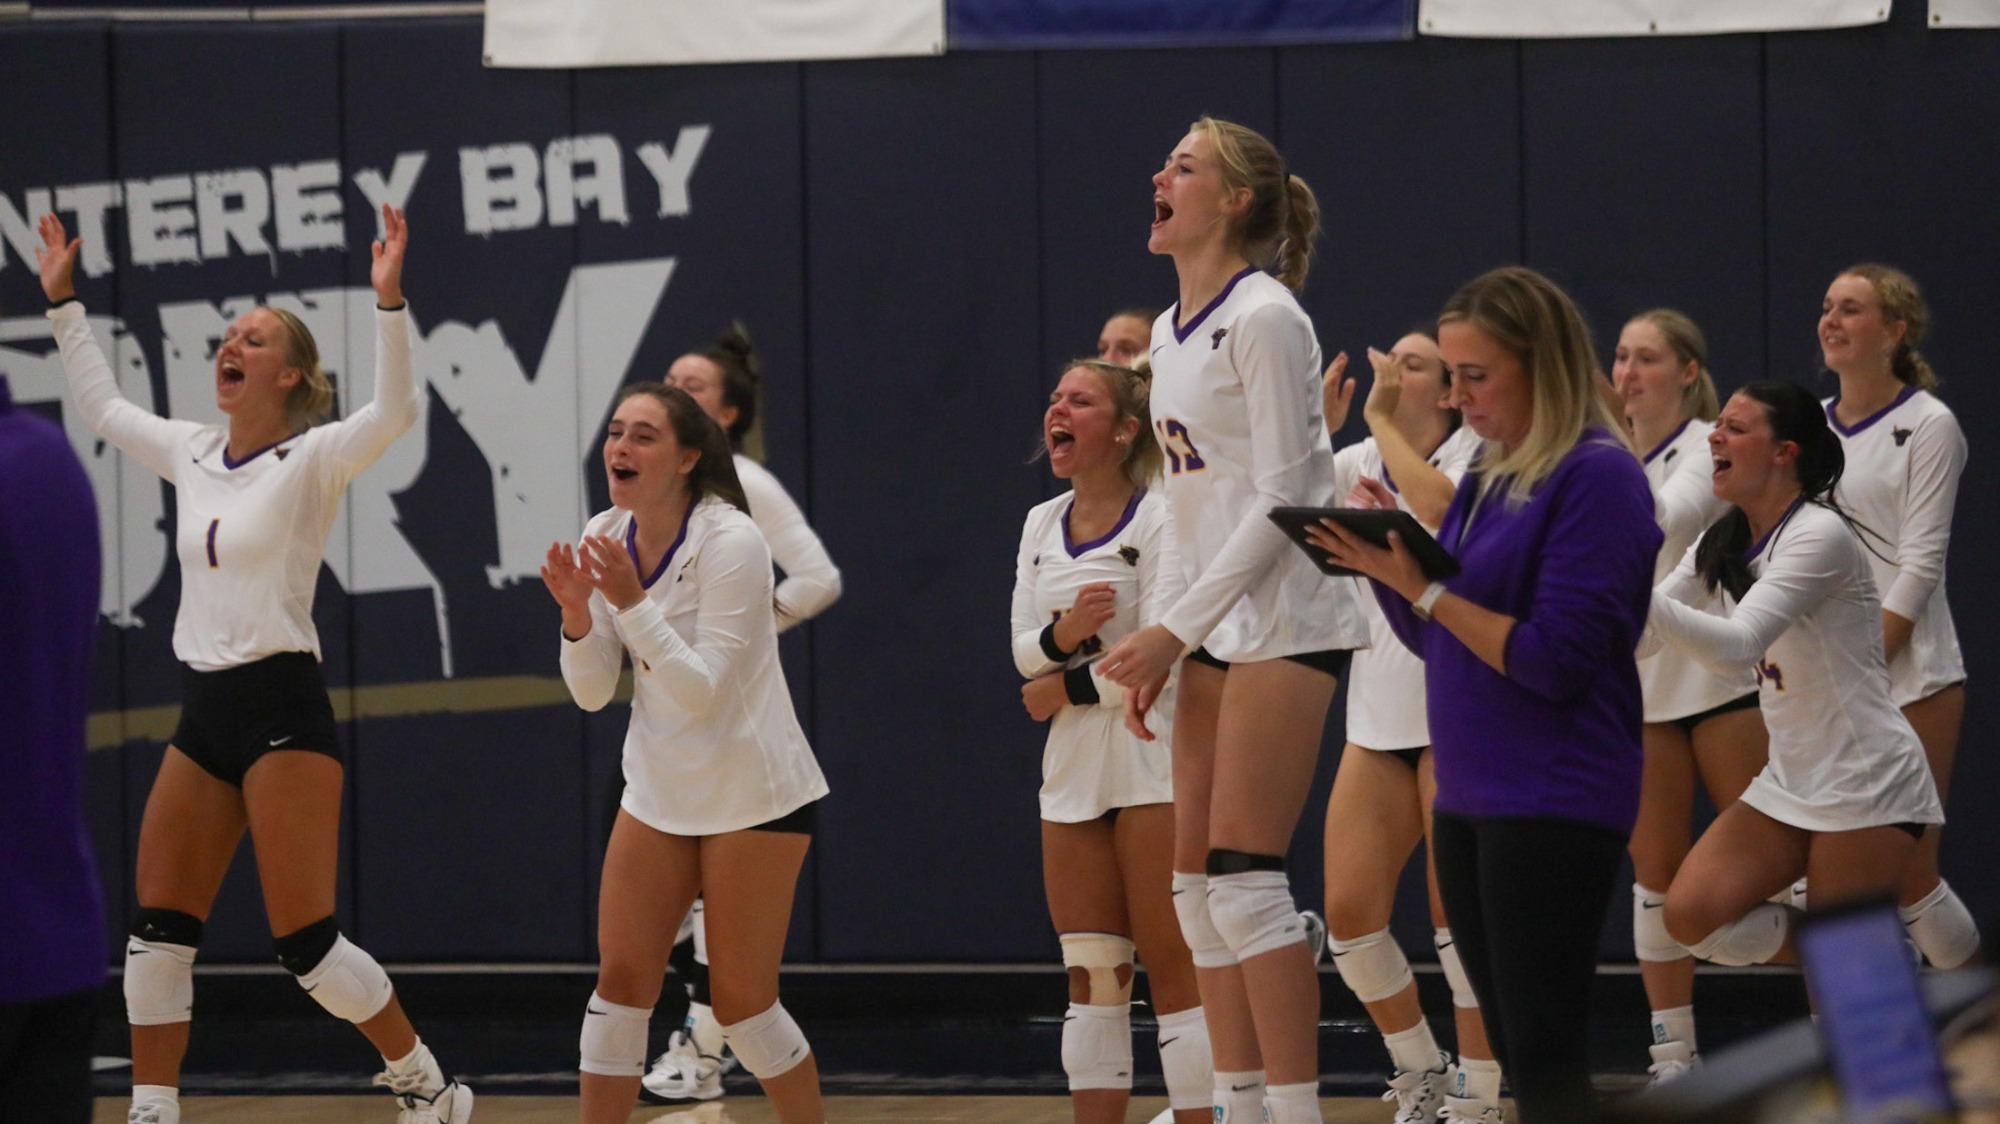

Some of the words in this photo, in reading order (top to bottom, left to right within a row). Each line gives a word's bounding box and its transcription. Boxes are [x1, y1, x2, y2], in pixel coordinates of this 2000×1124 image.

[459, 124, 712, 237] BAY
[1156, 417, 1206, 476] 13
[206, 518, 220, 570] 1
